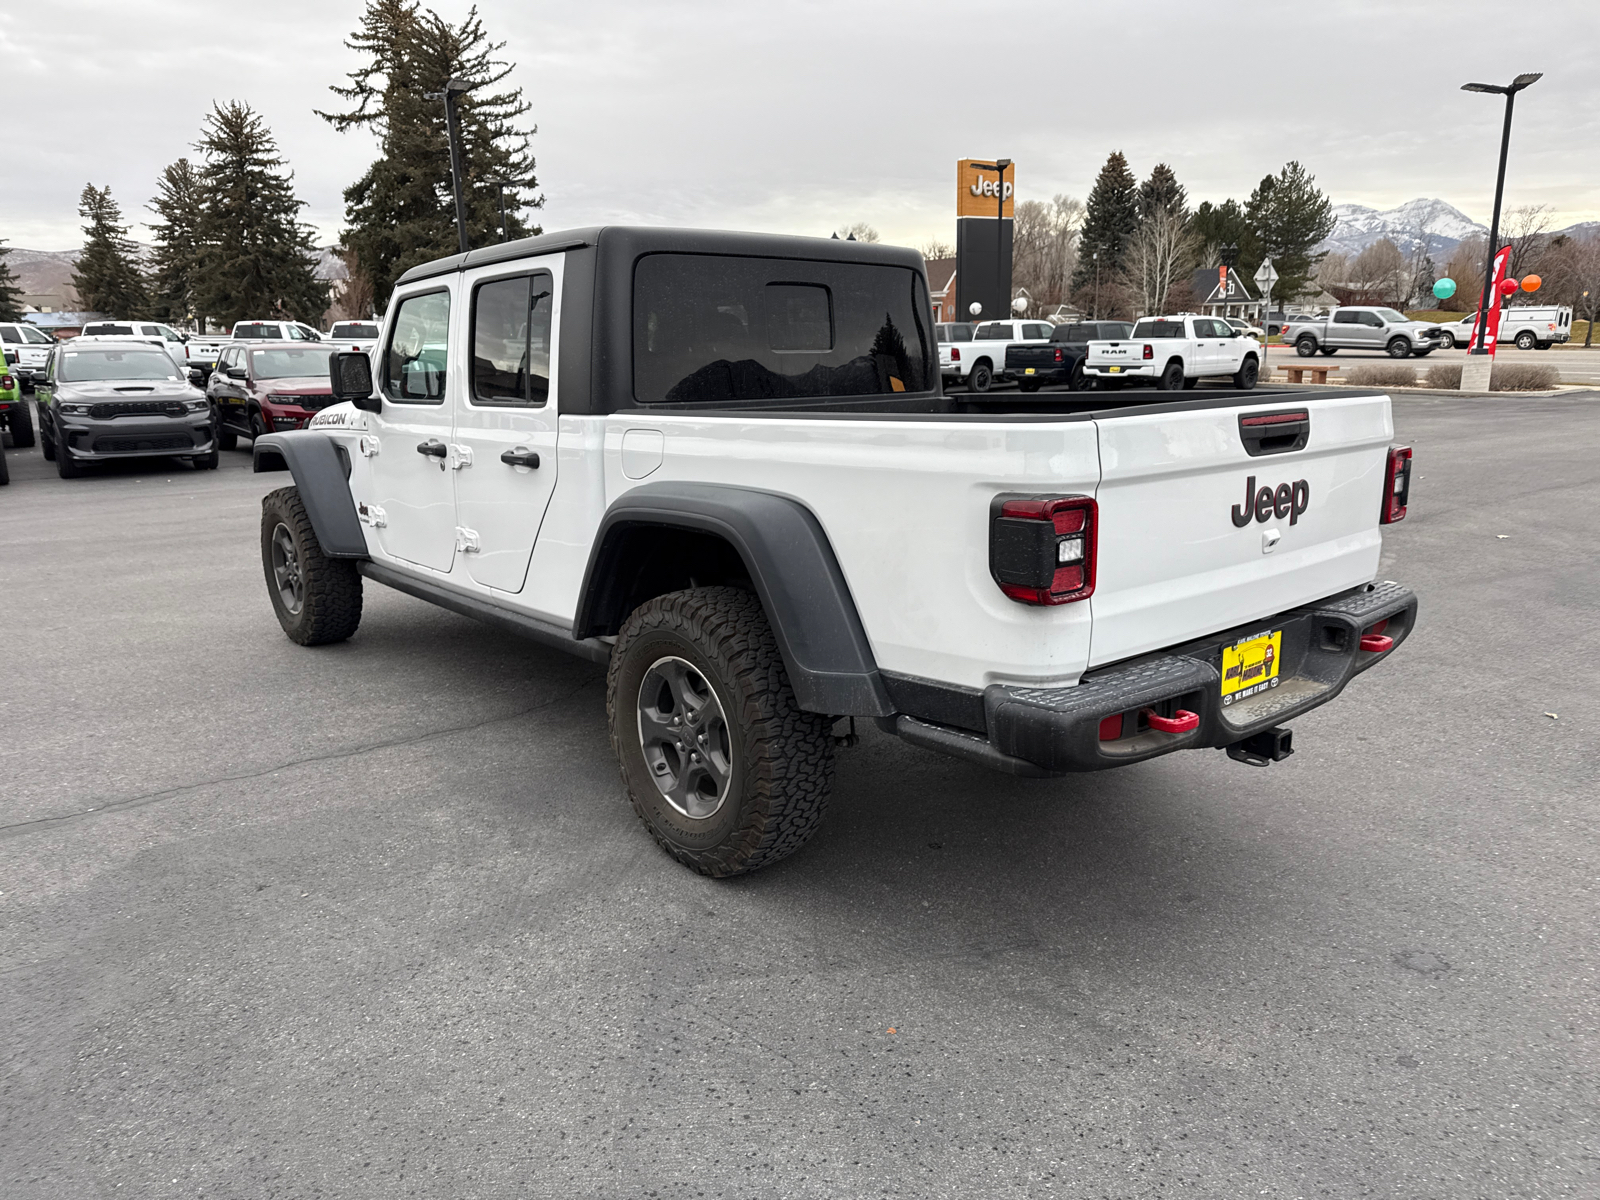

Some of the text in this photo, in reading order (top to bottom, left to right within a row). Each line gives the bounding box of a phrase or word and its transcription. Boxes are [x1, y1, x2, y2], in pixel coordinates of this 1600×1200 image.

[970, 175, 1012, 202] Jeep
[310, 413, 347, 426] RUBICON
[1231, 476, 1309, 527] Jeep
[1266, 648, 1273, 658] 32
[1235, 681, 1269, 700] WE MAKE IT EASY
